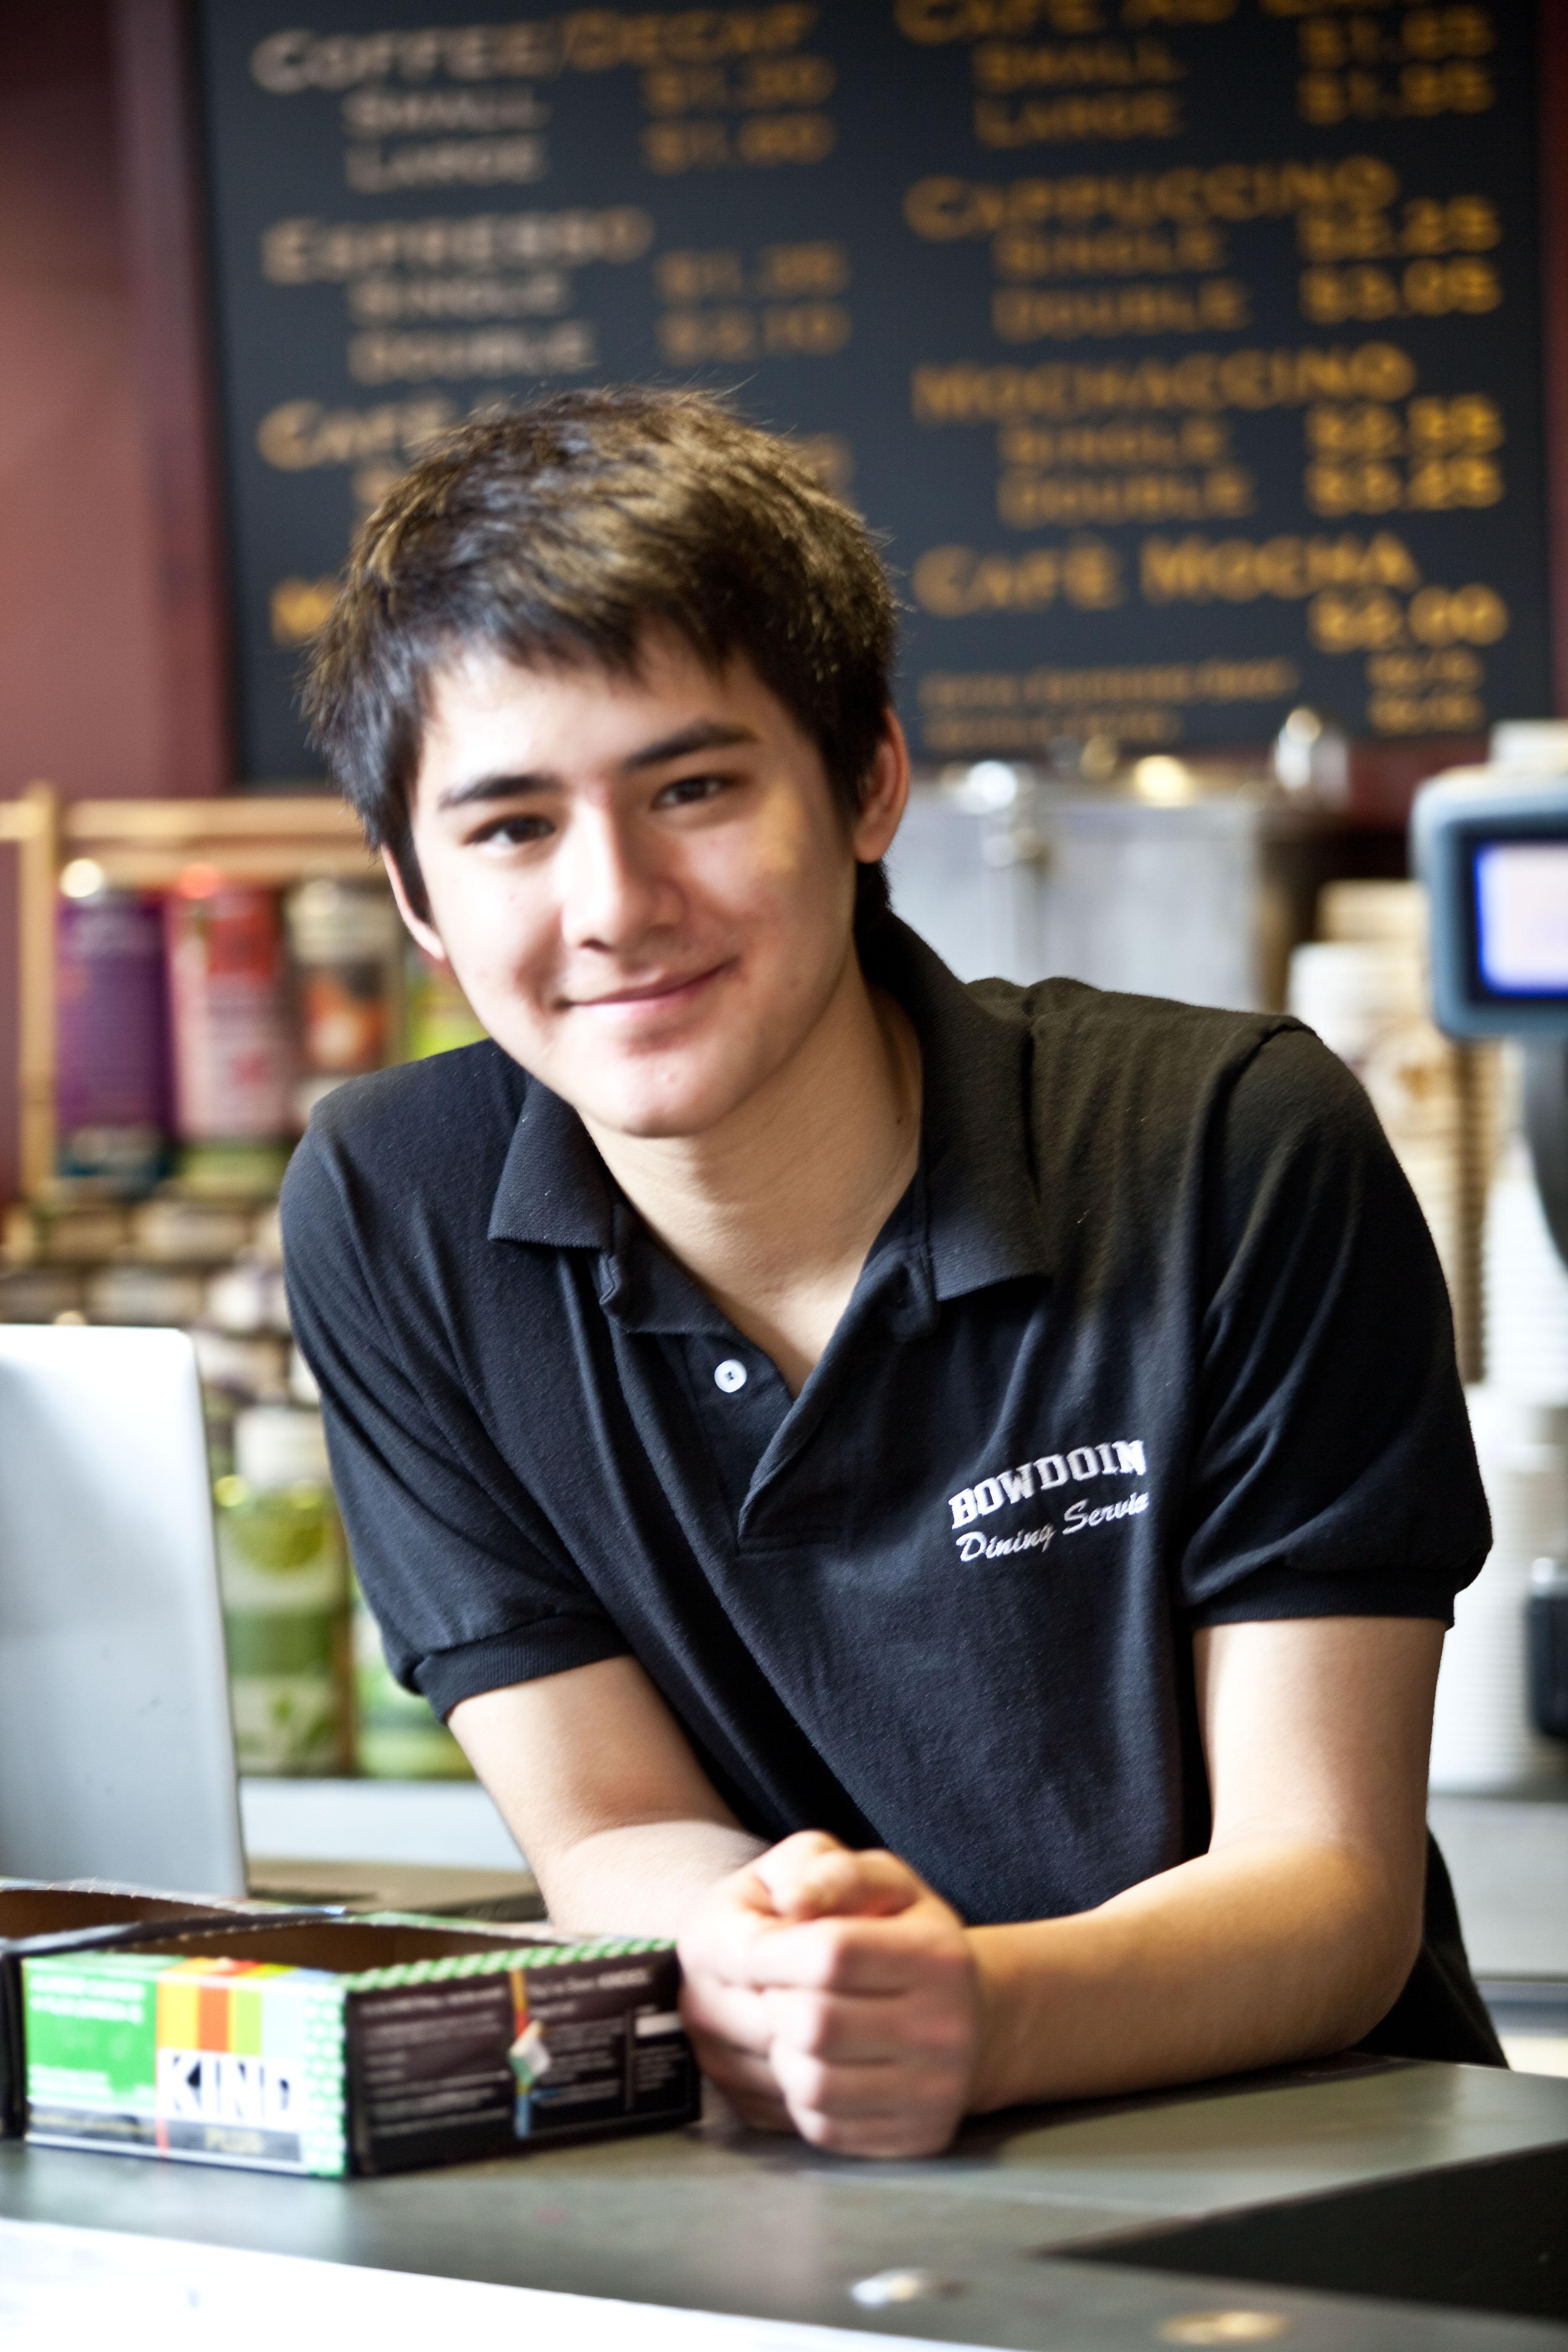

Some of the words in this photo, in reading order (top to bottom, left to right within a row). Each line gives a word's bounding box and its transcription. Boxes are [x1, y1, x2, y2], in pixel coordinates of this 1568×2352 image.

[979, 91, 1176, 144] LARGE
[348, 139, 537, 189] LARGE
[907, 160, 1395, 239] CAPPUCCINO
[996, 282, 1246, 339] DOUBLE
[915, 346, 1411, 419] MOCHACCINO
[1000, 468, 1248, 526] DOUBLE
[1142, 535, 1414, 598] MOCHA
[1312, 589, 1504, 650] $2.00
[949, 1439, 1146, 1529] BOWDOIN
[956, 1524, 1057, 1562] Dining
[160, 2051, 305, 2125] KIND
